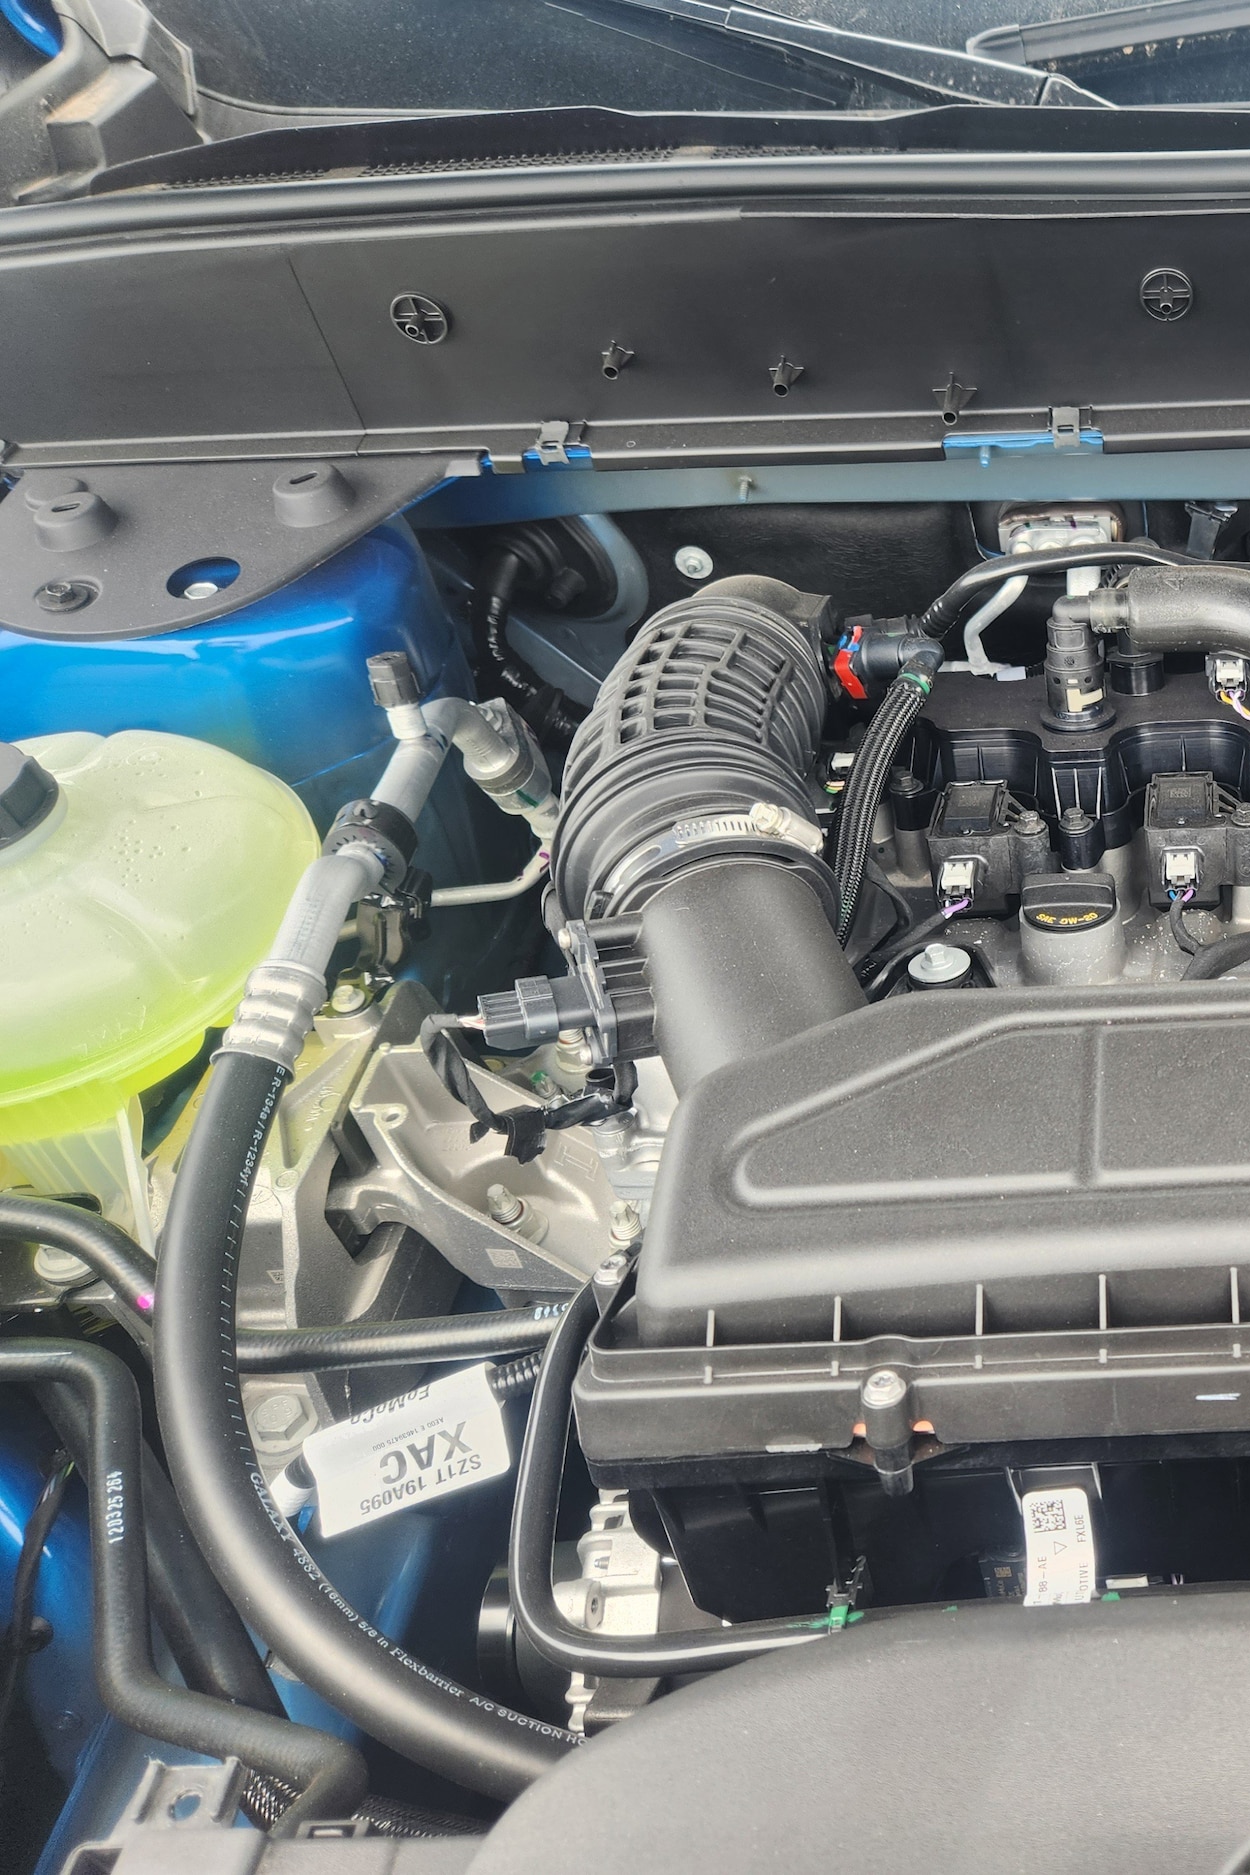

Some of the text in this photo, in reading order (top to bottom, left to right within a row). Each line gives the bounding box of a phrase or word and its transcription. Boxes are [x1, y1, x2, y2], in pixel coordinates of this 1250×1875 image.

[1036, 913, 1057, 924] SAE
[379, 1421, 473, 1485] XAC
[360, 1454, 482, 1516] SZ1T 19A095
[250, 1472, 295, 1542] GALAXY
[292, 1547, 321, 1581] 4882
[318, 1583, 360, 1623] (16mm)
[389, 1646, 465, 1699] Flexbarrier
[469, 1696, 495, 1712] A/C
[497, 1706, 564, 1740] SUCTION
